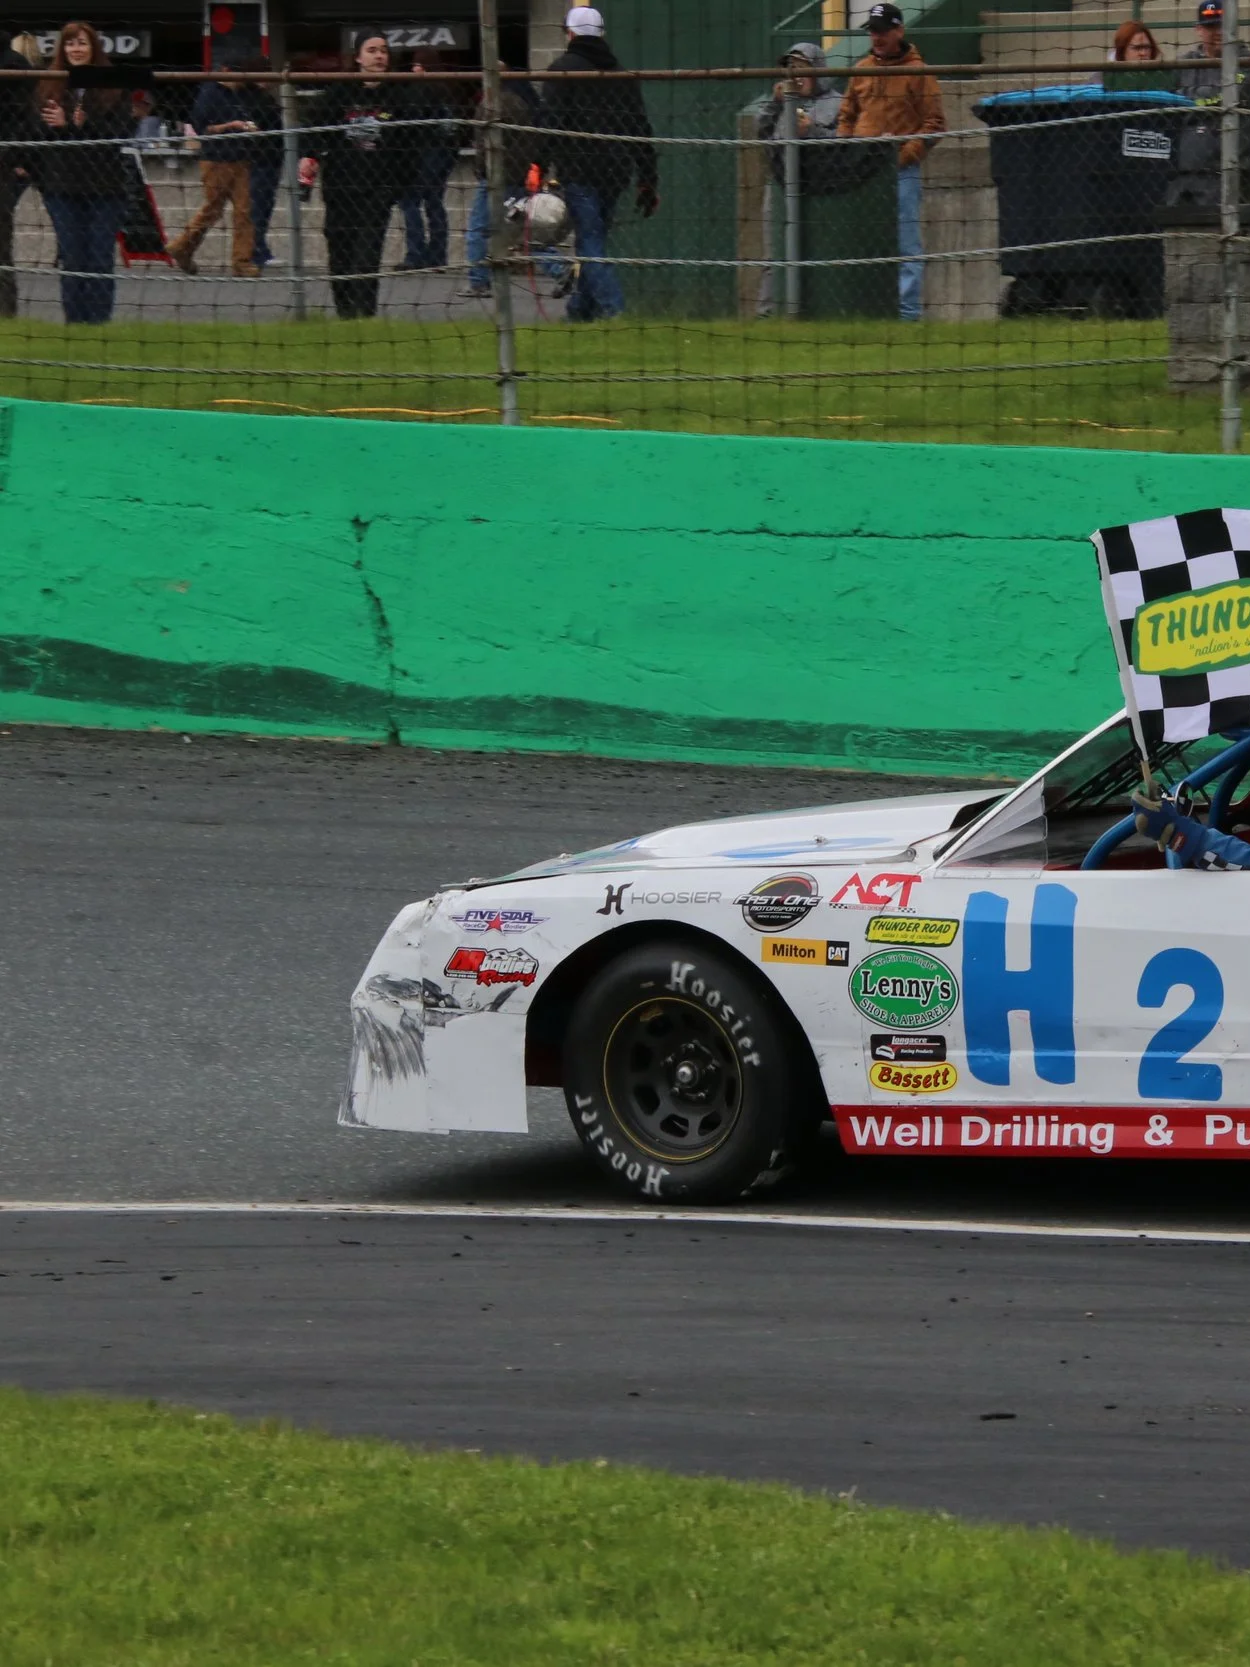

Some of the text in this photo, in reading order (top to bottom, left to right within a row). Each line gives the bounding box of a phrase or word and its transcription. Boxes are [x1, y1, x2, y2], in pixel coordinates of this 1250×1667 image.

[351, 28, 456, 47] ZZA
[631, 891, 722, 904] HOOSIER
[733, 894, 782, 905] FAST
[830, 872, 922, 908] ACT
[465, 911, 533, 922] FIVE STAR
[872, 921, 951, 934] THUNDER ROAD
[772, 943, 848, 960] Milton CAT
[861, 969, 952, 1007] Lenny's
[665, 961, 761, 1067] Hoosier
[861, 998, 949, 1025] SHOE & APPAREL
[878, 1066, 950, 1089] Bassett
[574, 1093, 670, 1196] Hoosier
[850, 1115, 943, 1147] Well
[960, 1115, 1115, 1154] Drilling
[1143, 1114, 1173, 1146] &
